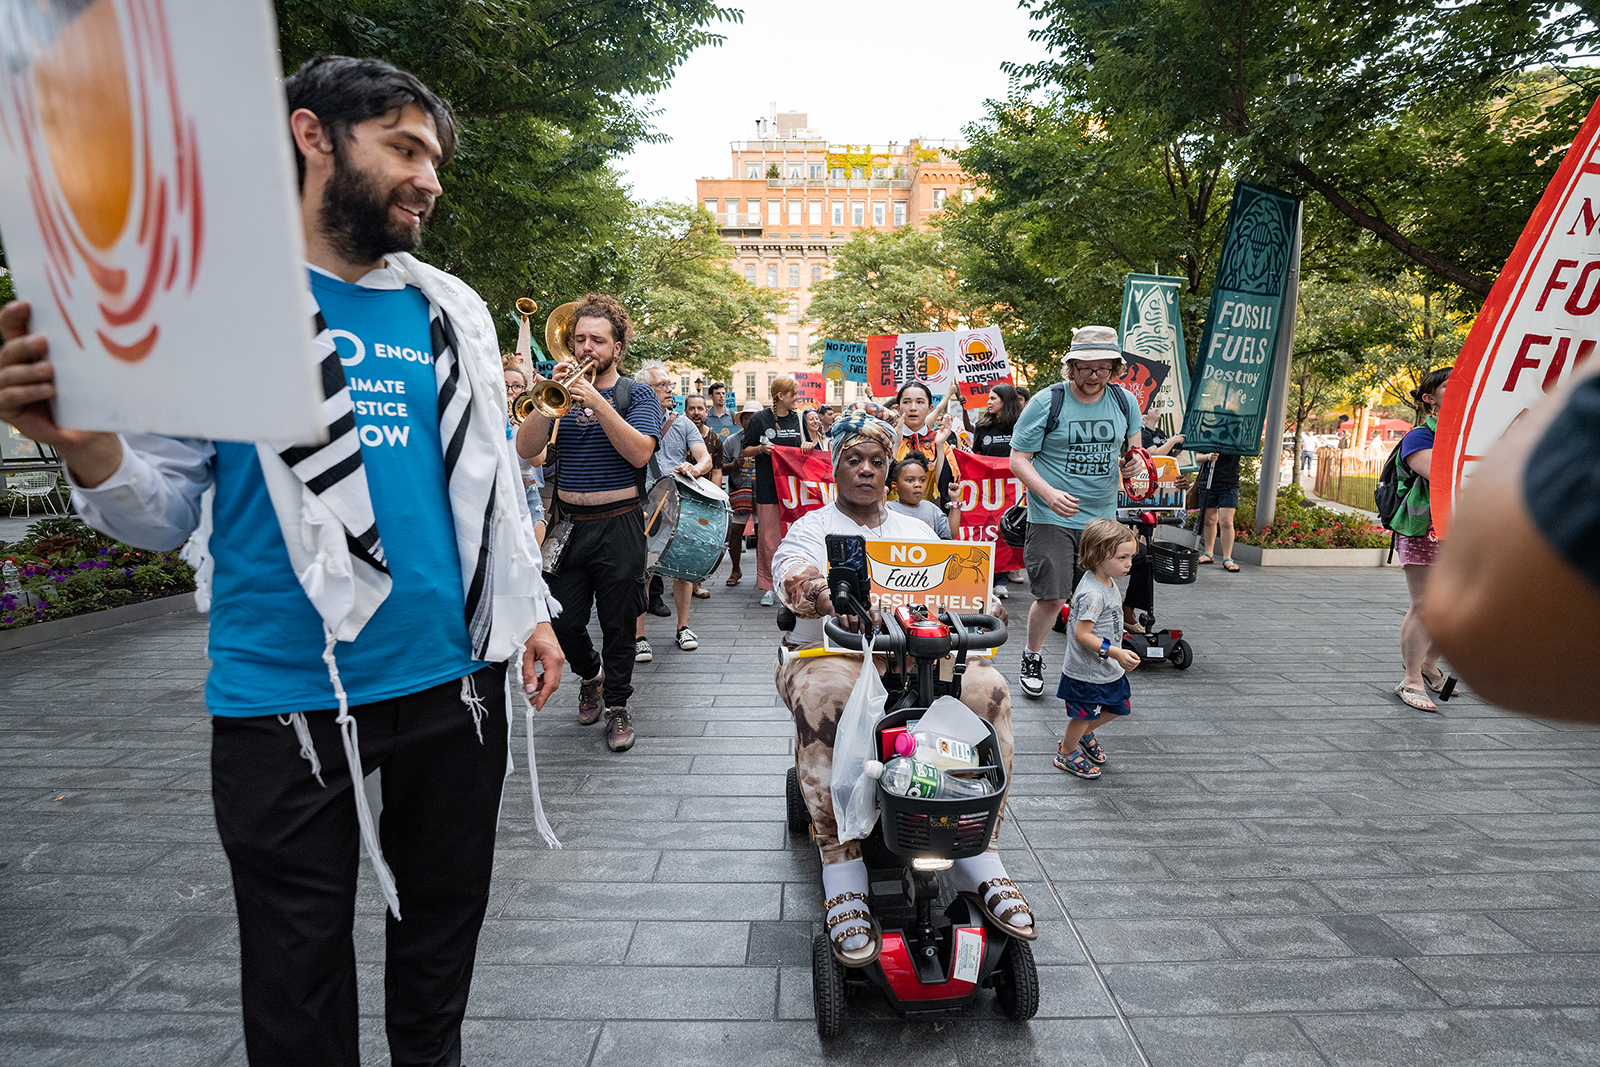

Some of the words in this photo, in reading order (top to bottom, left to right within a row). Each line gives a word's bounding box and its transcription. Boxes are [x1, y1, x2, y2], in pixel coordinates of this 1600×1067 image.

[1218, 301, 1271, 329] FOSSIL
[826, 342, 839, 351] NO
[840, 344, 861, 354] FAITH
[965, 350, 993, 362] STOP
[1208, 333, 1268, 365] FUELS
[538, 363, 554, 372] NO
[846, 355, 867, 364] FOSSI
[880, 350, 891, 386] FUELS
[893, 348, 903, 387] FOSSIL
[905, 341, 916, 381] FUNDIN
[918, 351, 928, 381] STOP
[957, 360, 1006, 374] FUNDING
[965, 372, 1004, 384] FOSSIL
[1203, 364, 1260, 387] Destroy
[347, 377, 405, 394] IMATE
[969, 384, 994, 395] FUE
[353, 401, 408, 417] STICE
[359, 424, 410, 447] OW
[1070, 421, 1115, 443] NO
[1101, 444, 1111, 452] IN
[1068, 453, 1110, 463] FOSSIL
[1066, 462, 1109, 475] FUELS
[890, 545, 927, 564] NO
[885, 568, 930, 588] Faith
[869, 592, 914, 608] OSSIL
[924, 594, 984, 610] FUELS
